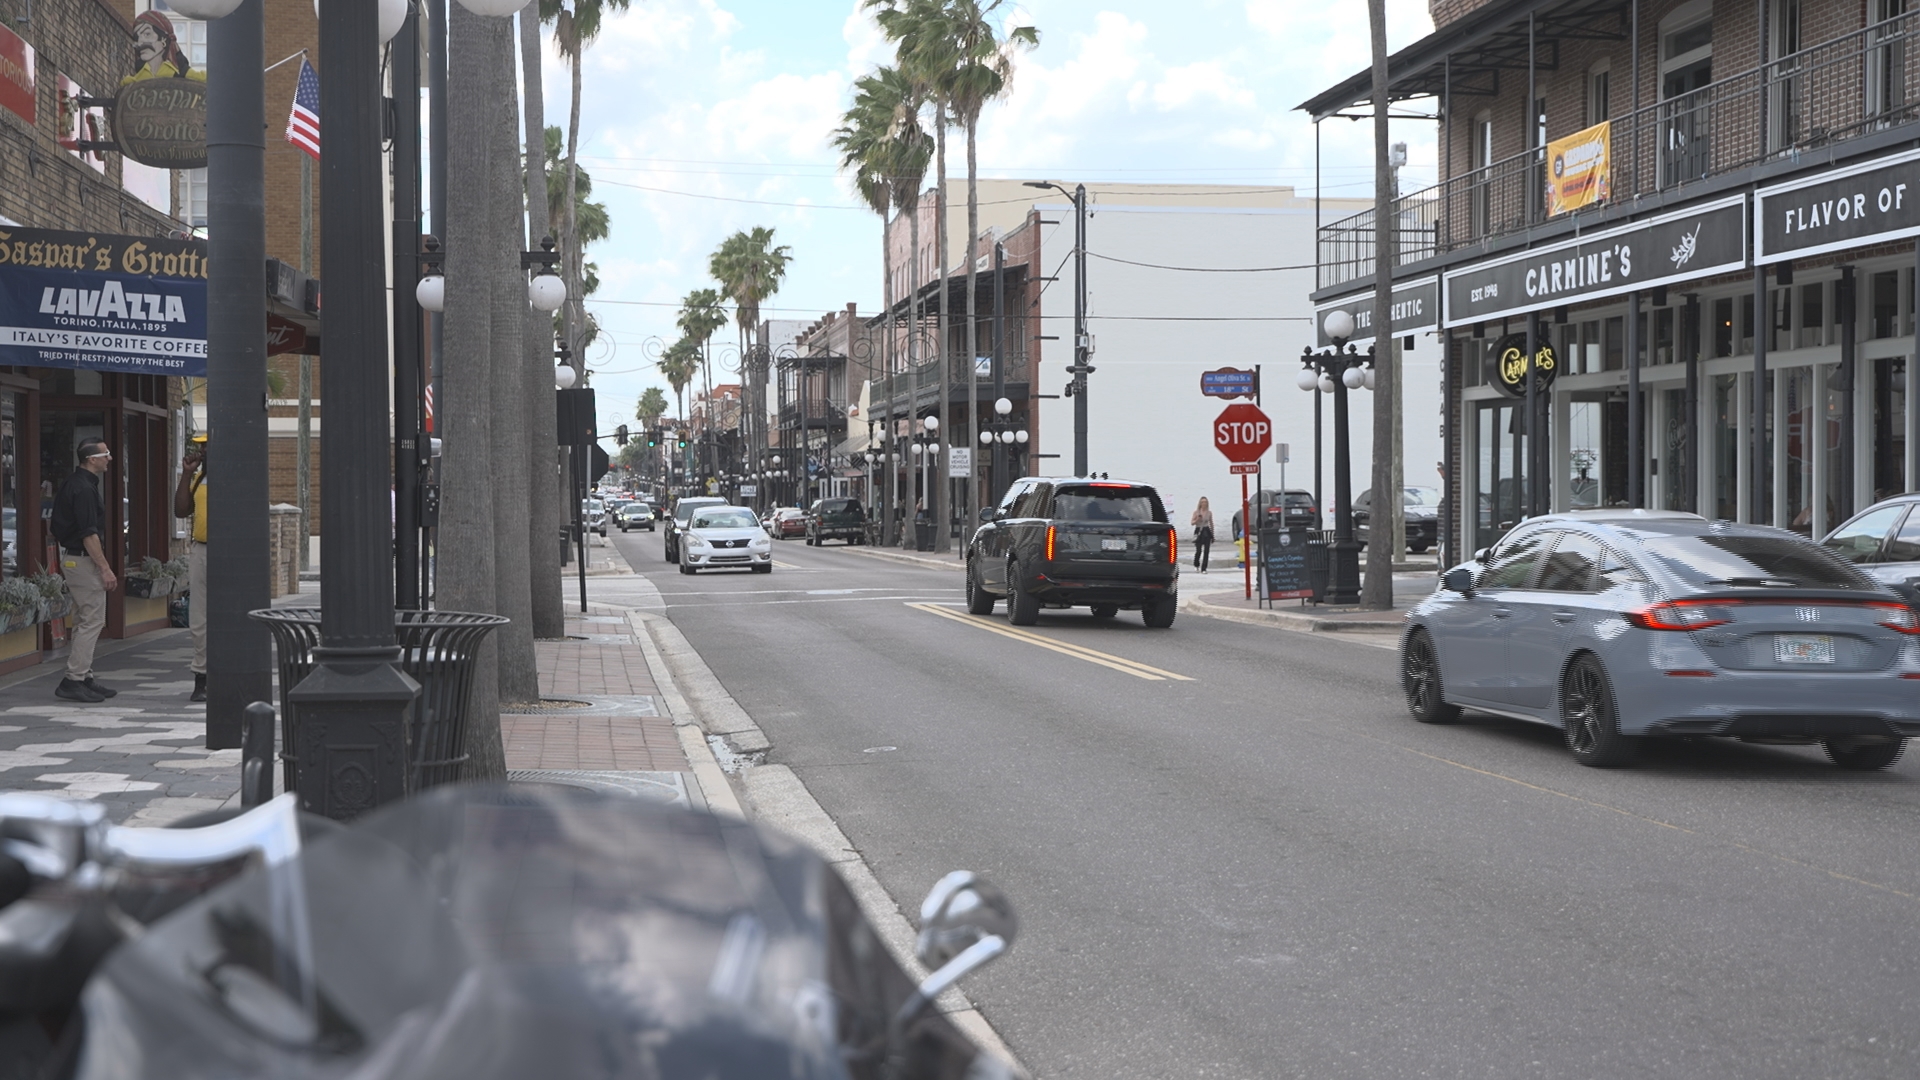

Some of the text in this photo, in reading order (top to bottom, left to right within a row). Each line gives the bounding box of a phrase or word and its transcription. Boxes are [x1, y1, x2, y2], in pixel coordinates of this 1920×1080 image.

[135, 117, 199, 142] Grotto
[169, 145, 207, 159] Famou
[1785, 183, 1906, 234] FLAVOR OF
[1525, 244, 1631, 297] CARMINE'S
[39, 280, 186, 323] LAVAZZA
[1471, 287, 1483, 302] EST.
[142, 322, 167, 332] 1895
[1356, 310, 1371, 329] THE
[13, 331, 208, 354] ITALY'S FAVORITE COFFEE
[38, 351, 185, 368] TRIED THE REST? NOW TRY THE BEST
[1217, 421, 1269, 446] STOP
